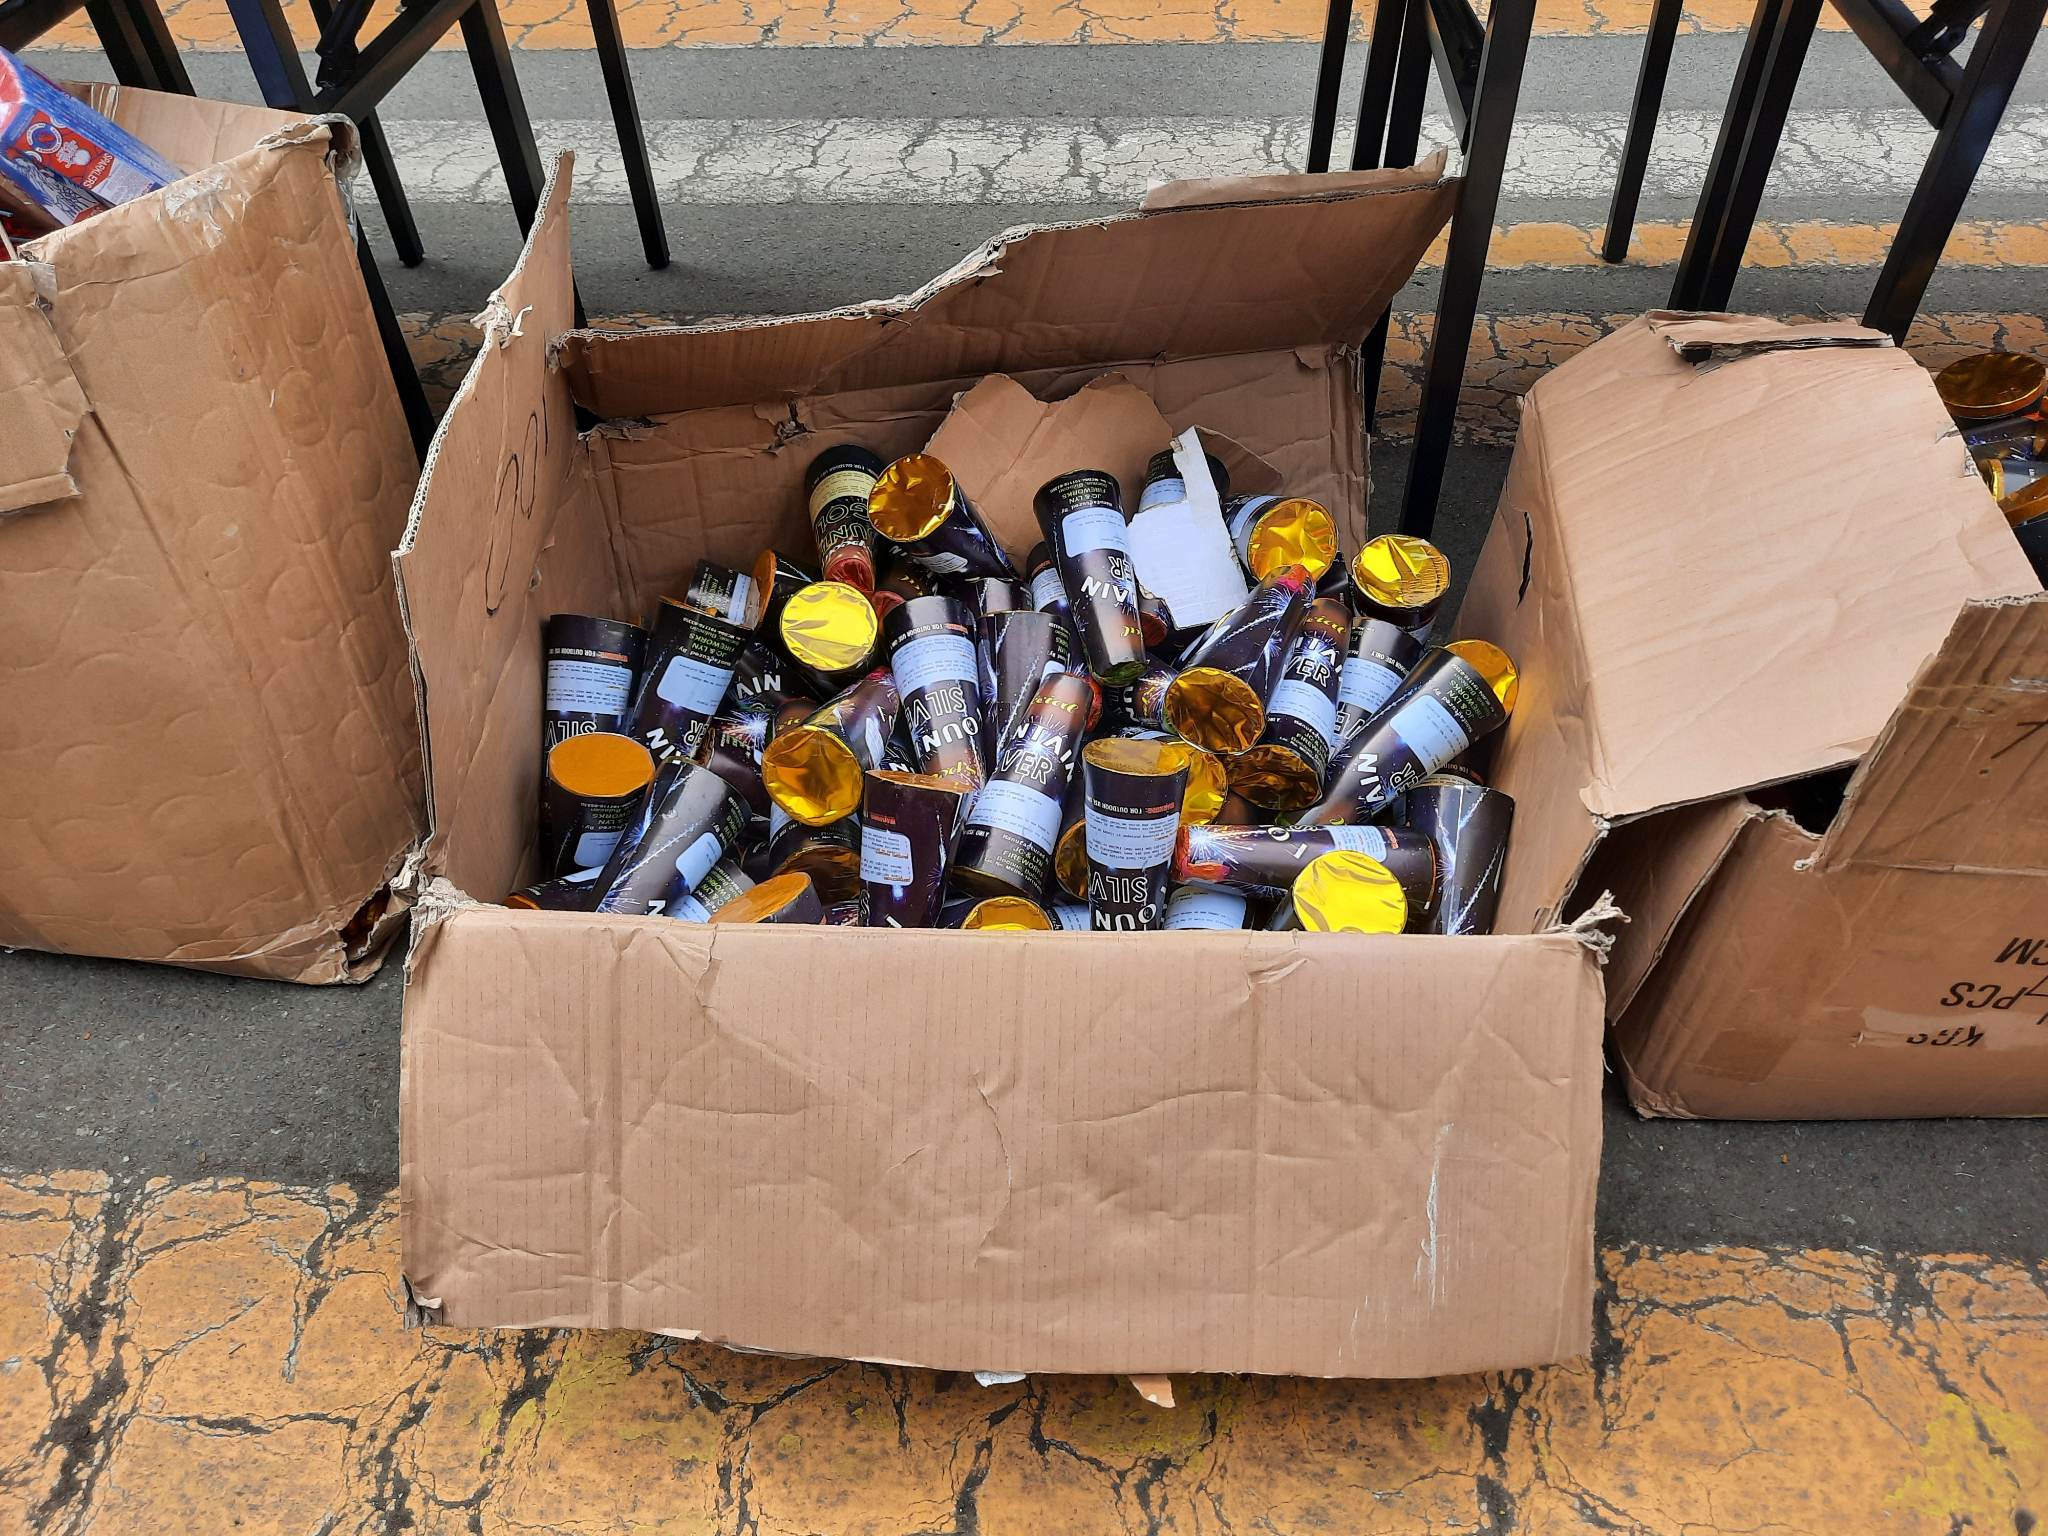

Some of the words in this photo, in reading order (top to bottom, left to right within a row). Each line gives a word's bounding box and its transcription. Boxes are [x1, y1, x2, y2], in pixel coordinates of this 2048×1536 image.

[82, 152, 113, 189] SPARKLERS
[1061, 487, 1106, 499] FIREWORKS
[688, 632, 735, 652] FIREWORKS
[1101, 802, 1129, 814] OUTDOOR
[1129, 807, 1143, 815] FOR
[1940, 982, 2028, 1010] PCS
